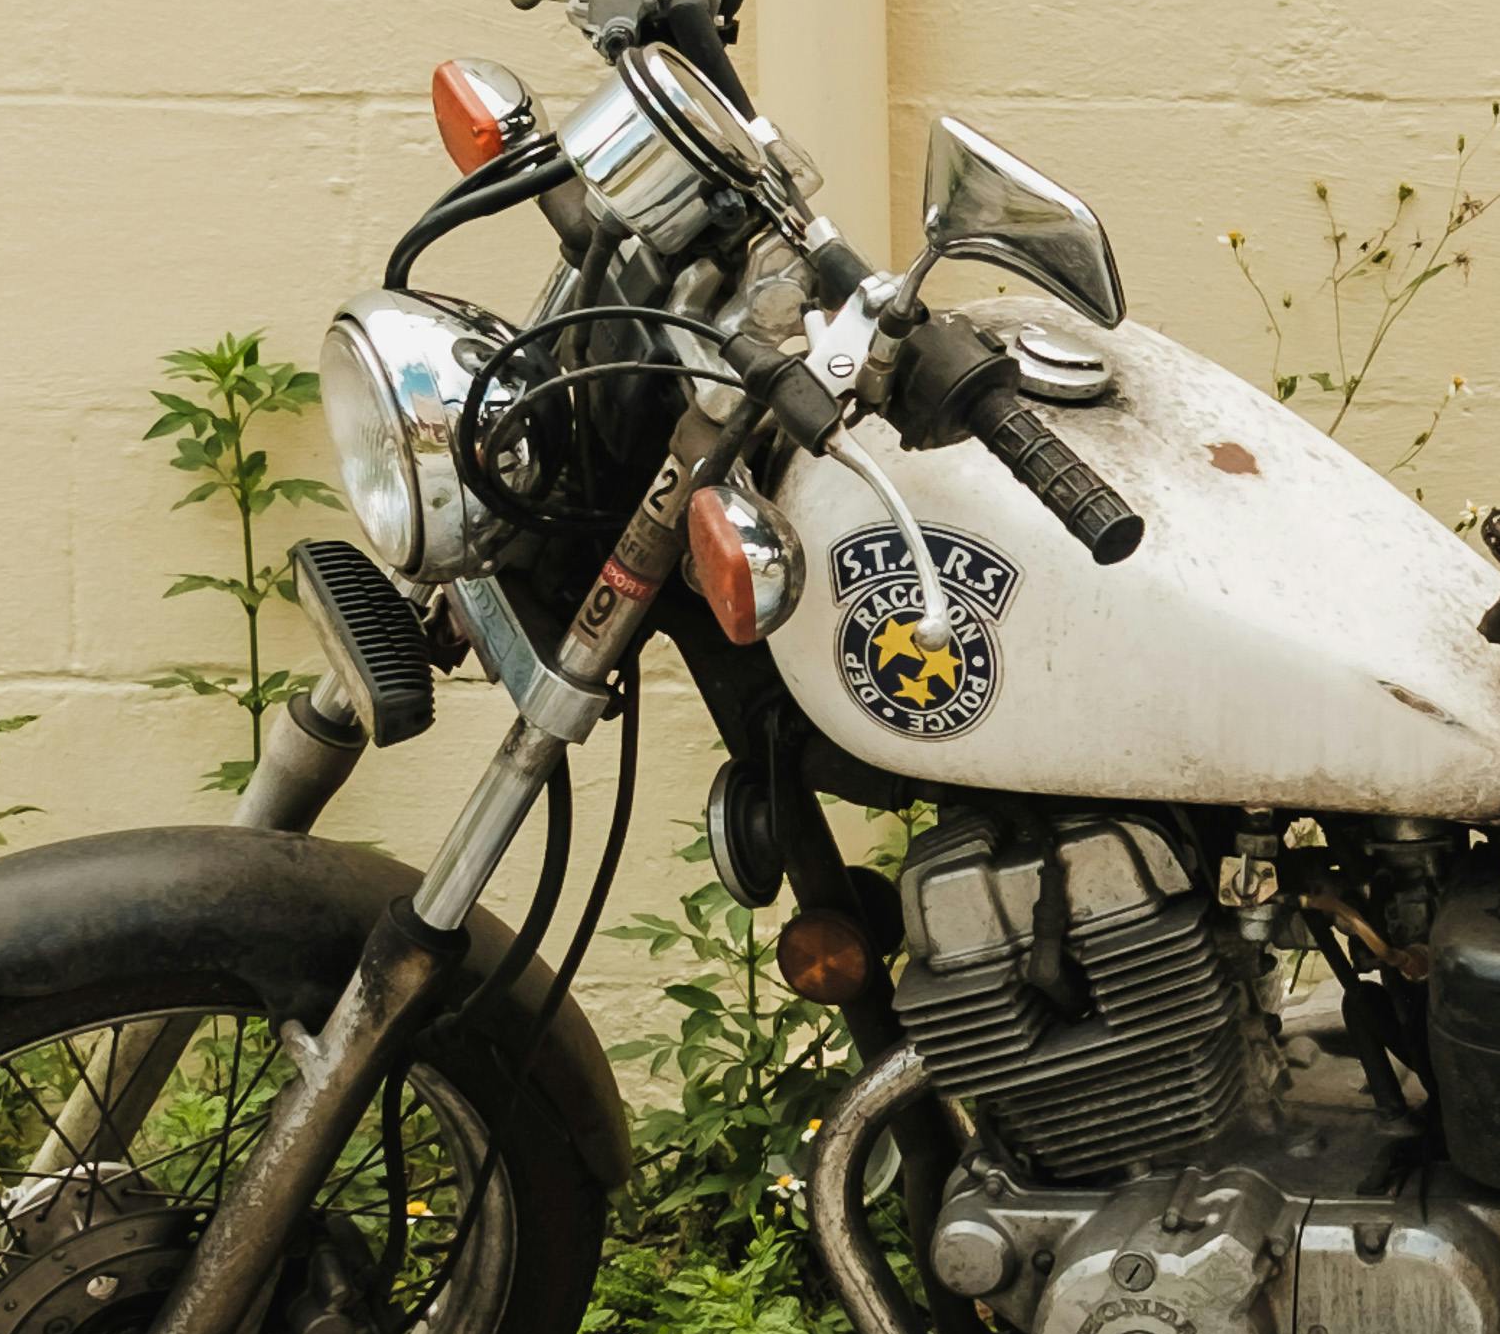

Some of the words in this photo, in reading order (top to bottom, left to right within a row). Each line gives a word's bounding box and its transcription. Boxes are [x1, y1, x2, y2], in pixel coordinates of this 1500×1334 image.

[649, 468, 678, 512] 2
[585, 585, 617, 627] 9
[854, 585, 982, 644] RACCON
[844, 651, 881, 705] DEP
[908, 673, 988, 733] POLICE
